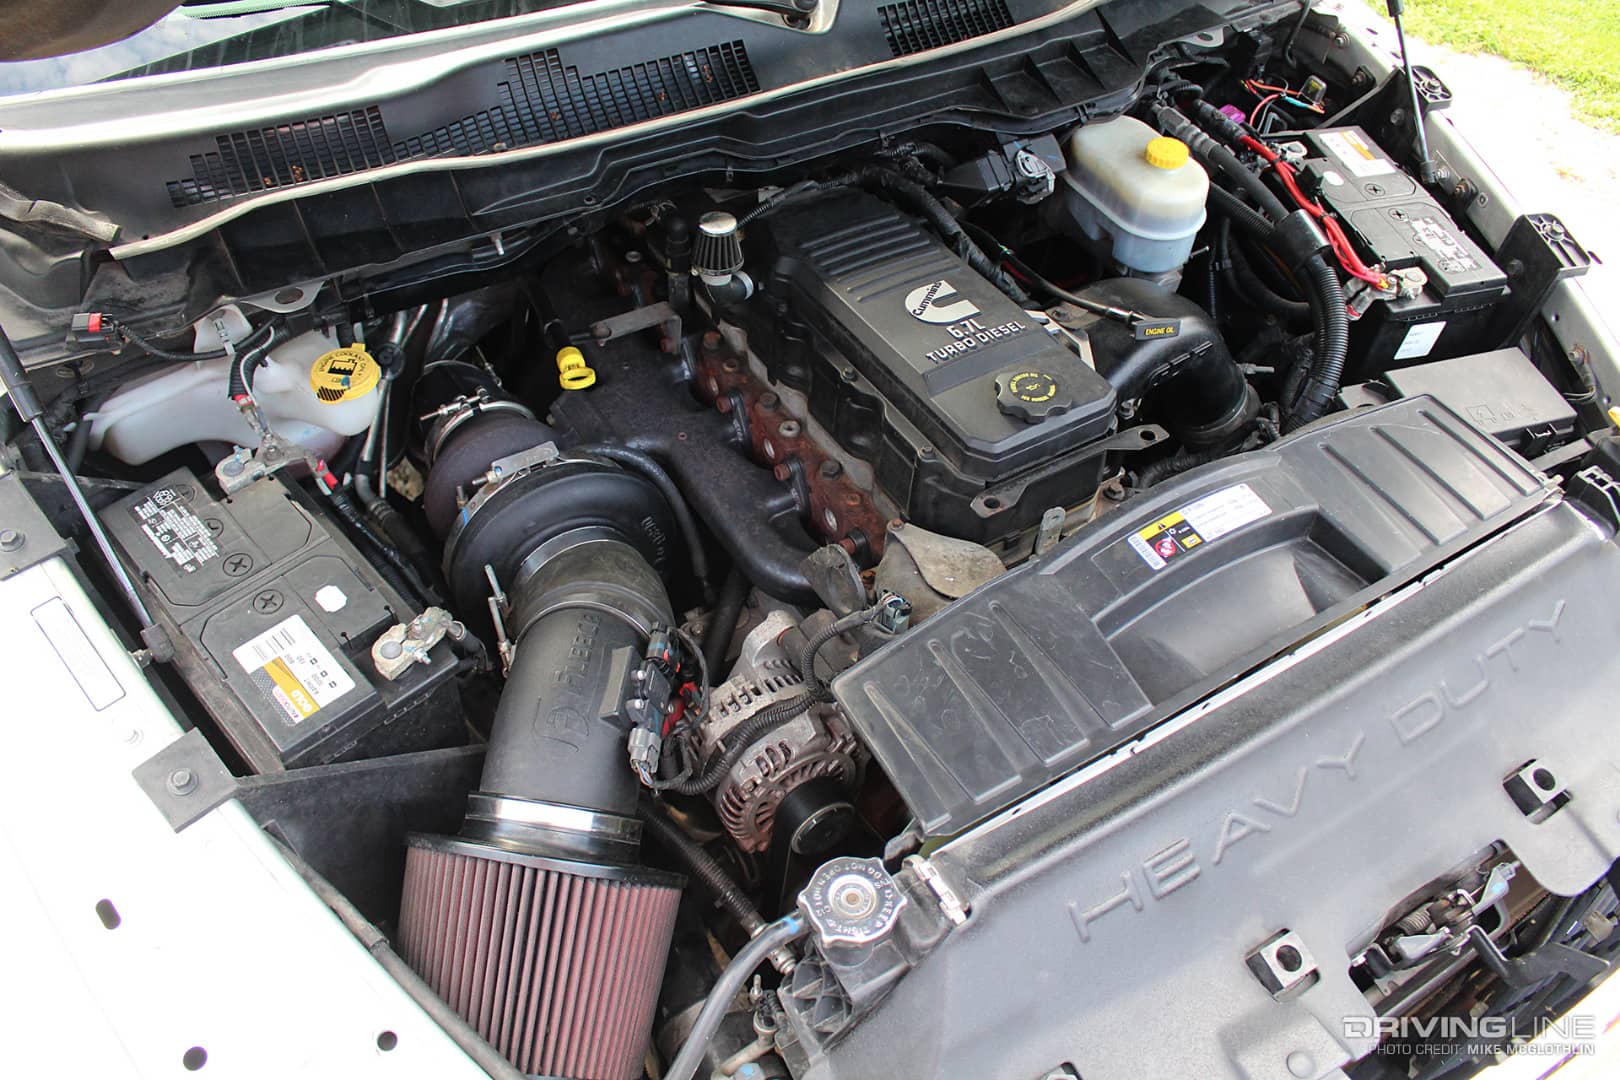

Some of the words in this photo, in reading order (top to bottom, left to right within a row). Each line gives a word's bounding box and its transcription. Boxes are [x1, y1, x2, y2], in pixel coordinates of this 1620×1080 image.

[912, 280, 943, 317] Cummins
[925, 337, 977, 364] TURBO
[975, 320, 1026, 344] DIESEL
[946, 318, 988, 340] 6.7L
[1145, 327, 1165, 336] ENGINE
[1165, 326, 1175, 334] OIL
[1067, 729, 1366, 943] HEAVY
[1391, 599, 1567, 746] DUTY
